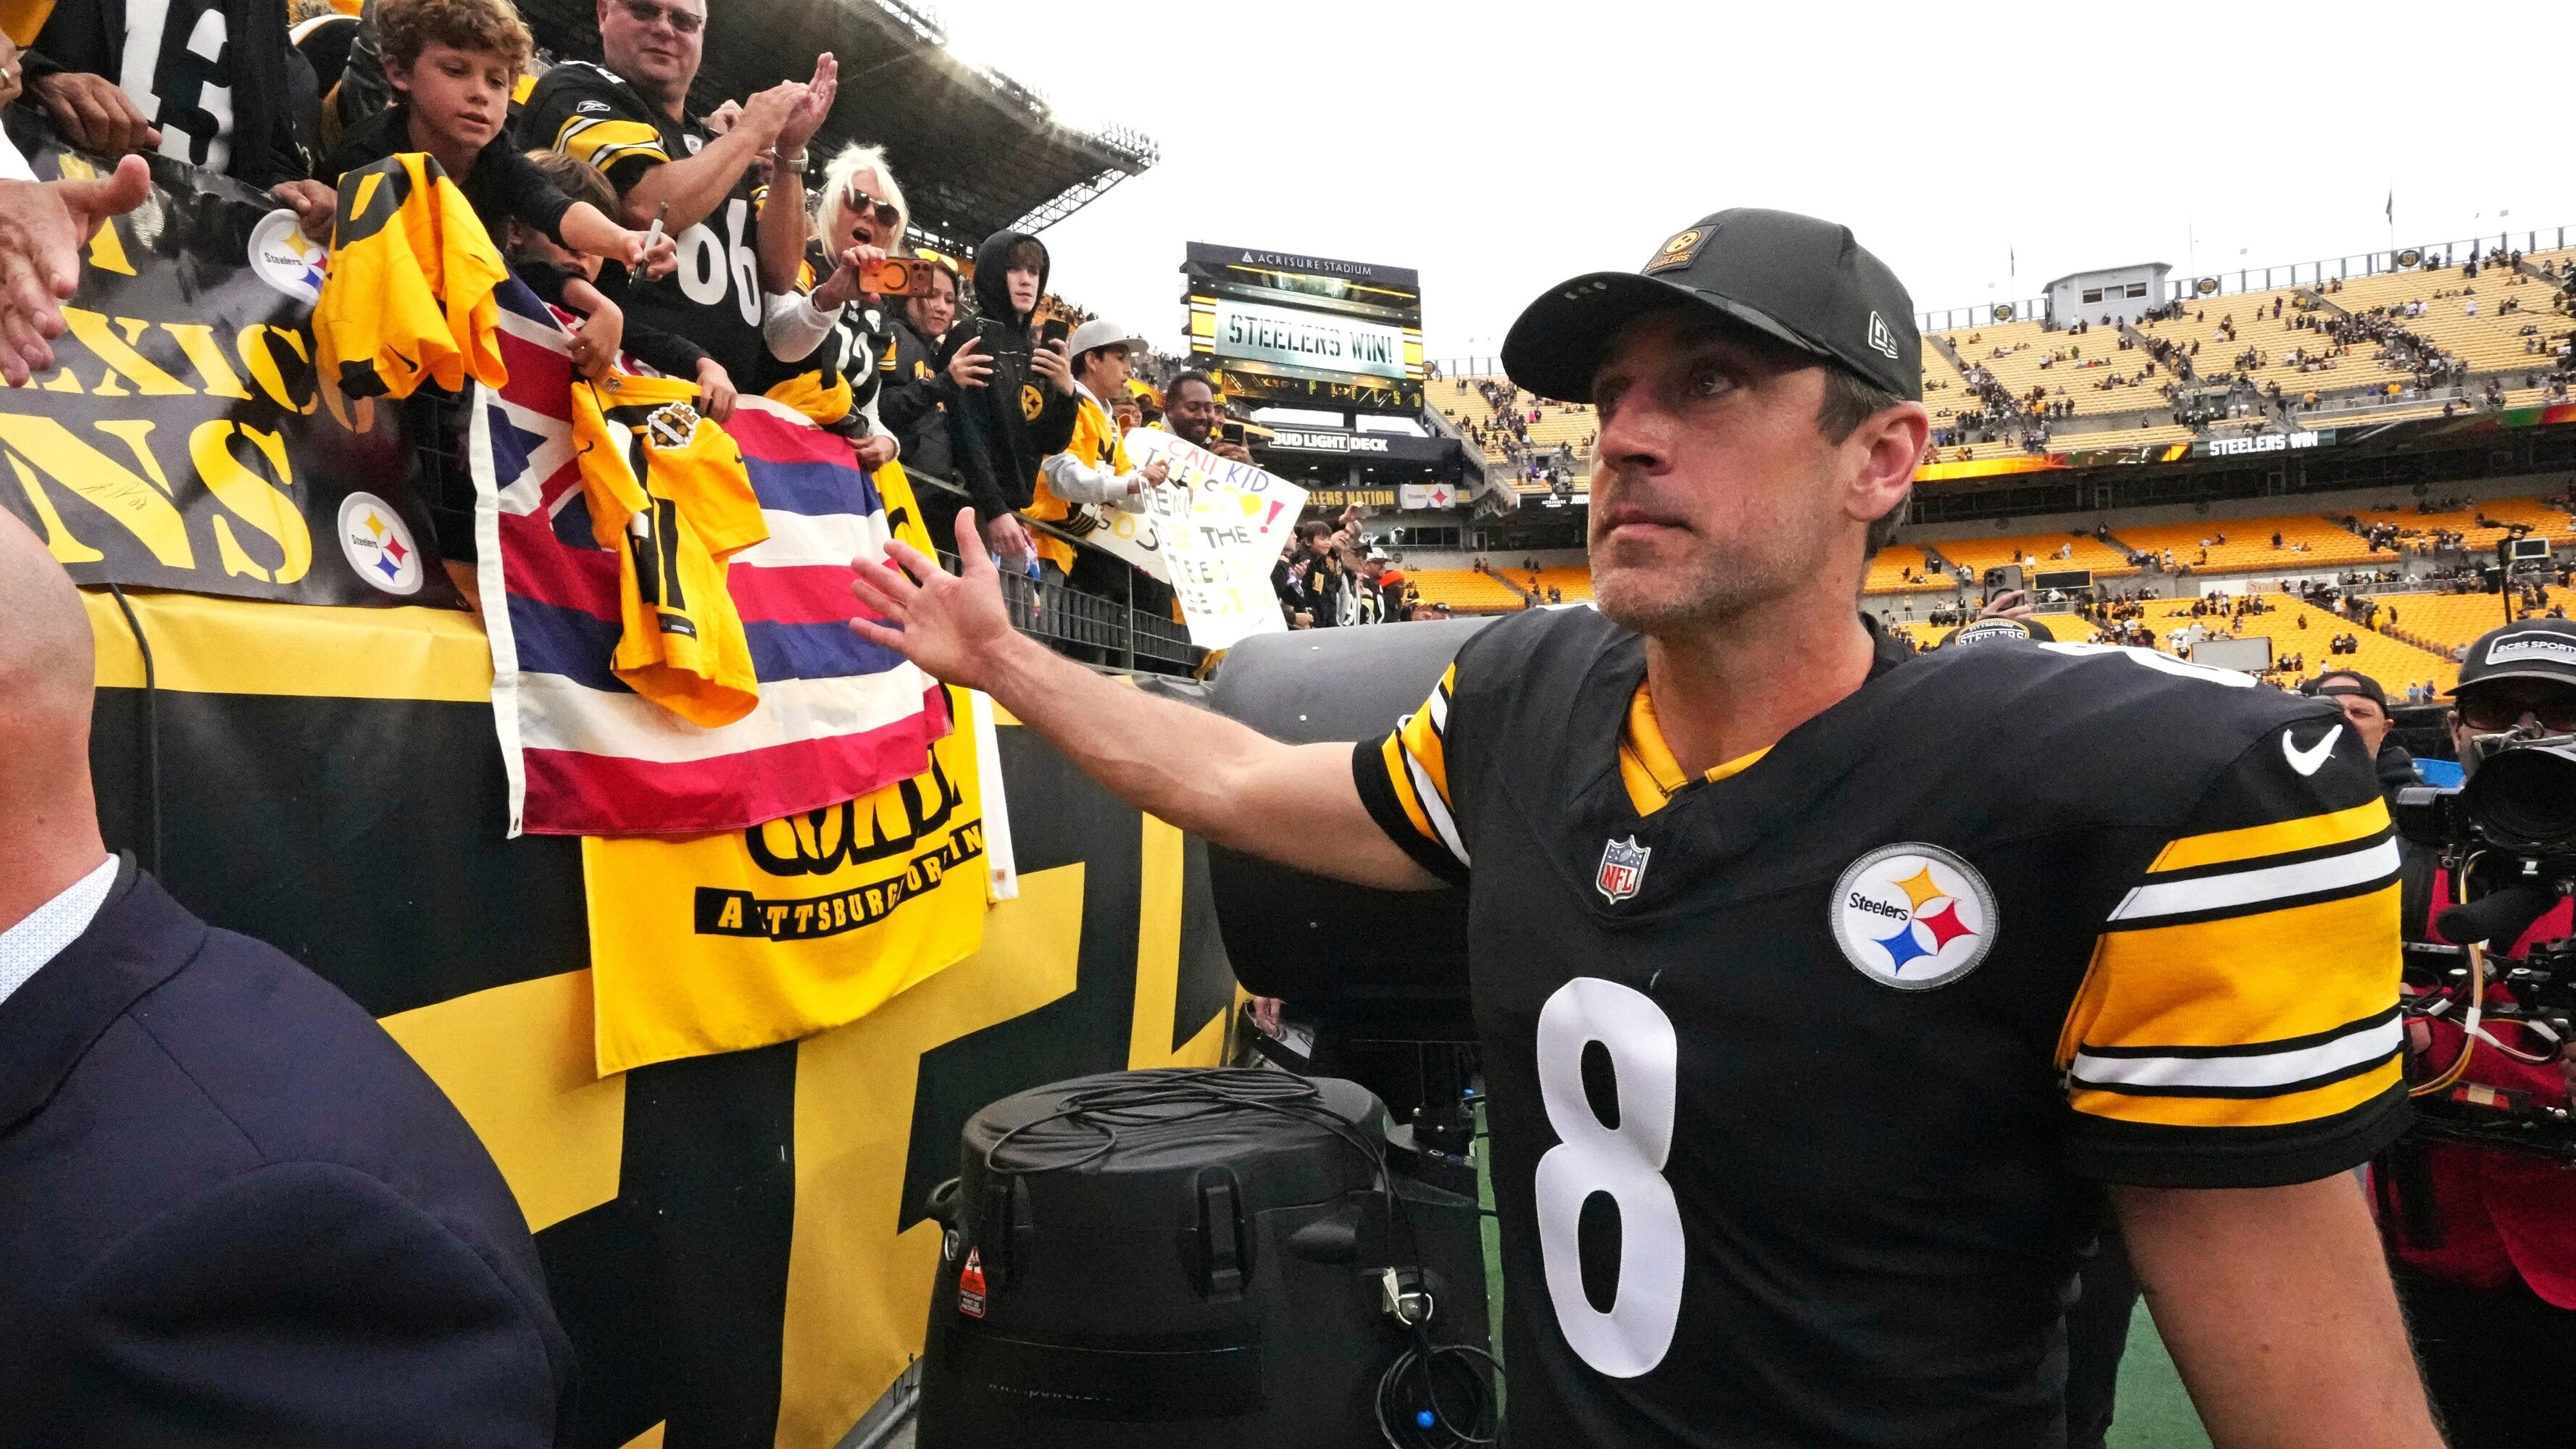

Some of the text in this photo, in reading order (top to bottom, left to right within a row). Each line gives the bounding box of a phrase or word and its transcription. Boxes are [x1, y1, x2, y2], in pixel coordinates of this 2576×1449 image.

[264, 252, 302, 266] Steelers
[1258, 254, 1372, 276] ACRISURE STADIUM
[1229, 314, 1393, 364] STEELERS WIN!
[1273, 433, 1388, 451] BUD LIGHT DECK
[2210, 431, 2319, 456] STEELERS WIN
[1225, 462, 1270, 493] KID
[1346, 490, 1395, 505] NATION
[1199, 525, 1251, 549] THE
[2506, 640, 2576, 652] CBS SPORT
[1601, 864, 1633, 893] NFL
[718, 896, 743, 929] A
[1848, 892, 1909, 922] Steelers
[1535, 977, 1685, 1379] 8
